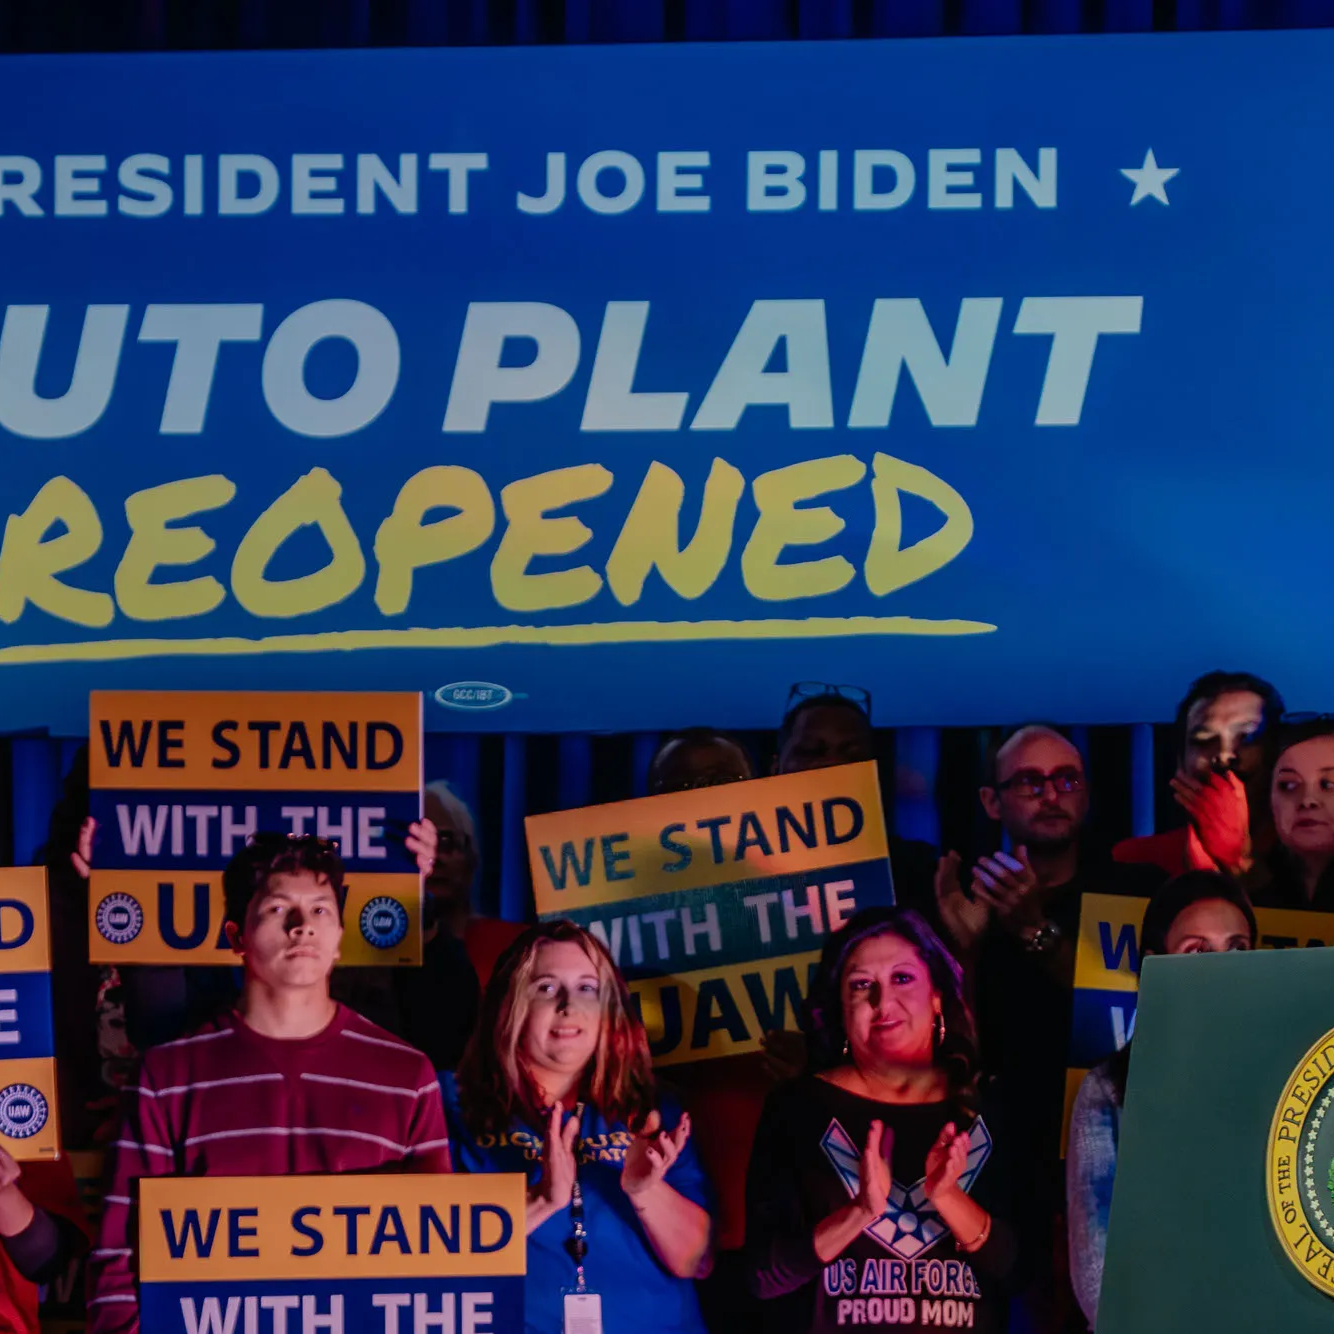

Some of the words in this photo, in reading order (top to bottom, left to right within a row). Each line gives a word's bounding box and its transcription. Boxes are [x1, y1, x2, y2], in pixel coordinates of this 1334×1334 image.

[517, 150, 712, 215] JOE
[746, 147, 1059, 212] BIDEN
[440, 295, 1145, 434] PLANT
[100, 720, 186, 768] WE
[211, 720, 404, 770] STAND
[115, 804, 258, 858] WITH
[281, 806, 387, 859] THE
[539, 832, 635, 891] WE
[657, 796, 865, 874] STAND
[743, 878, 857, 945] THE
[8, 1104, 31, 1118] UAW
[1279, 1154, 1292, 1195] THE
[160, 1207, 260, 1259] WE
[291, 1204, 514, 1257] STAND
[1280, 1201, 1297, 1224] OF
[824, 1258, 857, 1297] US
[859, 1258, 909, 1296] AIR
[837, 1297, 916, 1326] PROUD
[921, 1298, 975, 1329] MOM
